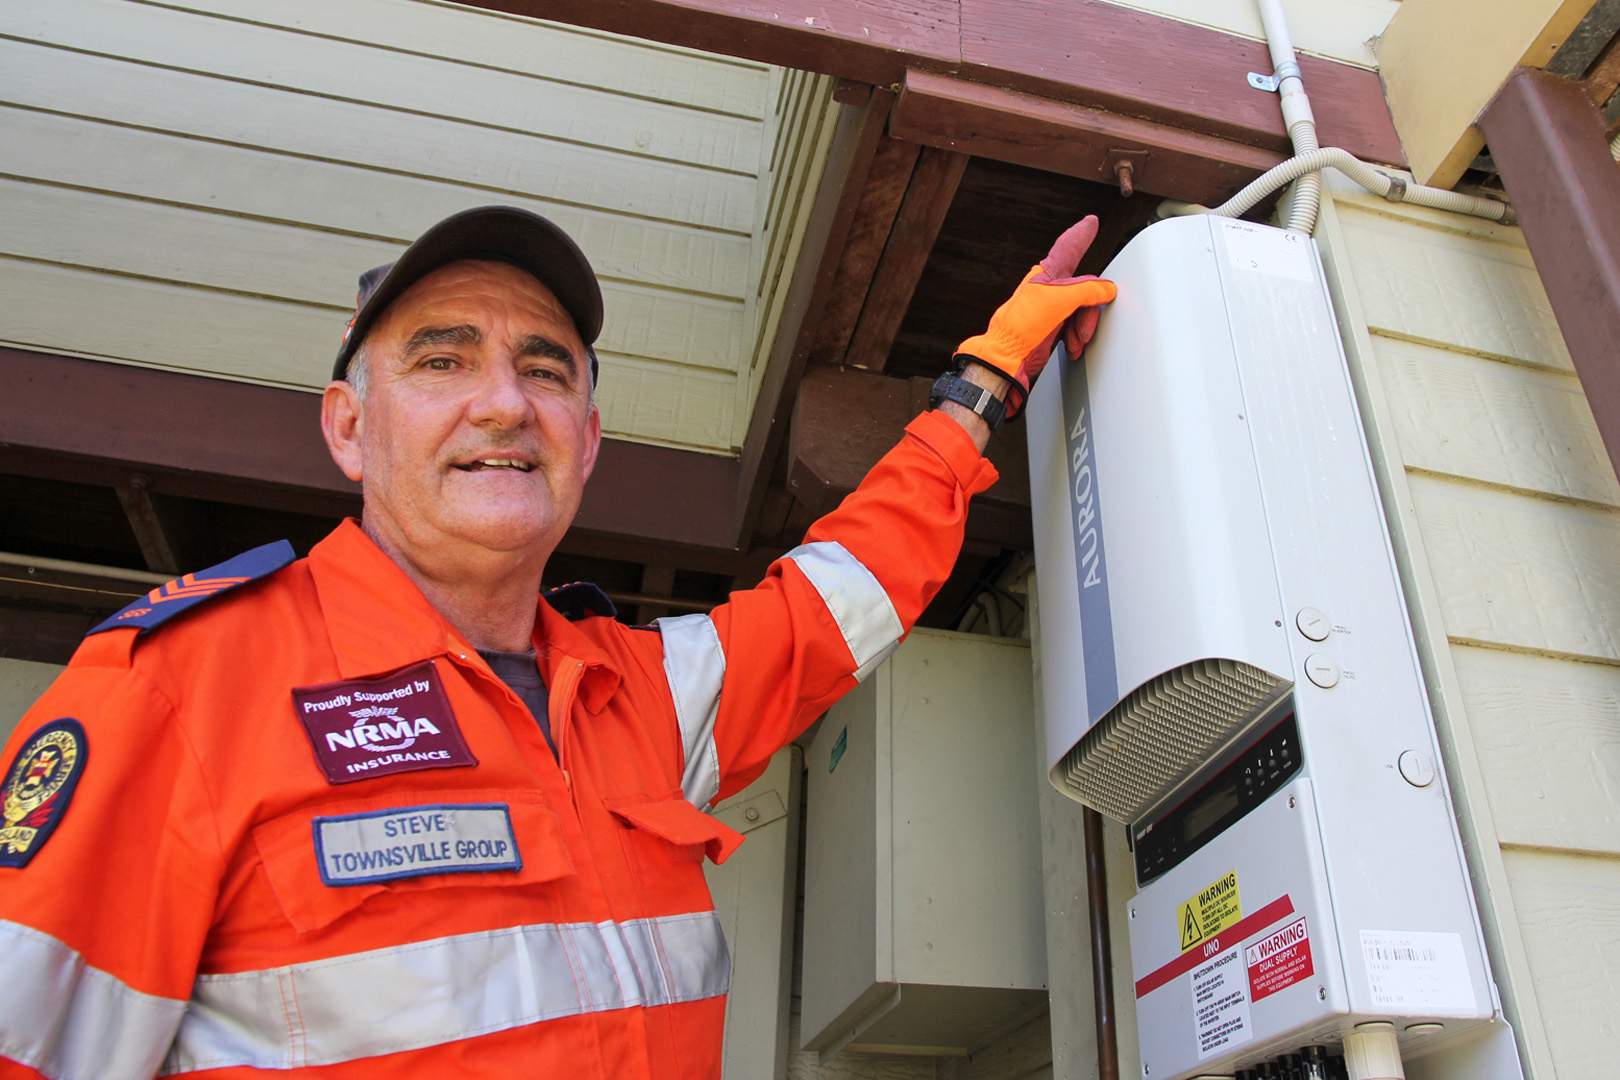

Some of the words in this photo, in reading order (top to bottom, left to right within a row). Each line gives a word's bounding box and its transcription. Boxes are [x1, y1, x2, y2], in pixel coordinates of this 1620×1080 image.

[1070, 407, 1101, 588] AURORA
[304, 694, 352, 713] Proudly
[354, 685, 413, 704] Supported
[415, 680, 429, 695] by
[325, 717, 440, 751] NRMA
[346, 750, 450, 773] INSURANCE
[384, 814, 446, 837] STEVE
[331, 841, 452, 873] TOWNSVILLE
[456, 839, 508, 859] GROUP
[1198, 873, 1236, 907] WARNING
[1203, 938, 1219, 957] UNO
[1258, 922, 1305, 959] WARNING
[1259, 959, 1275, 973] DUAL
[1275, 946, 1298, 965] SUPPLY
